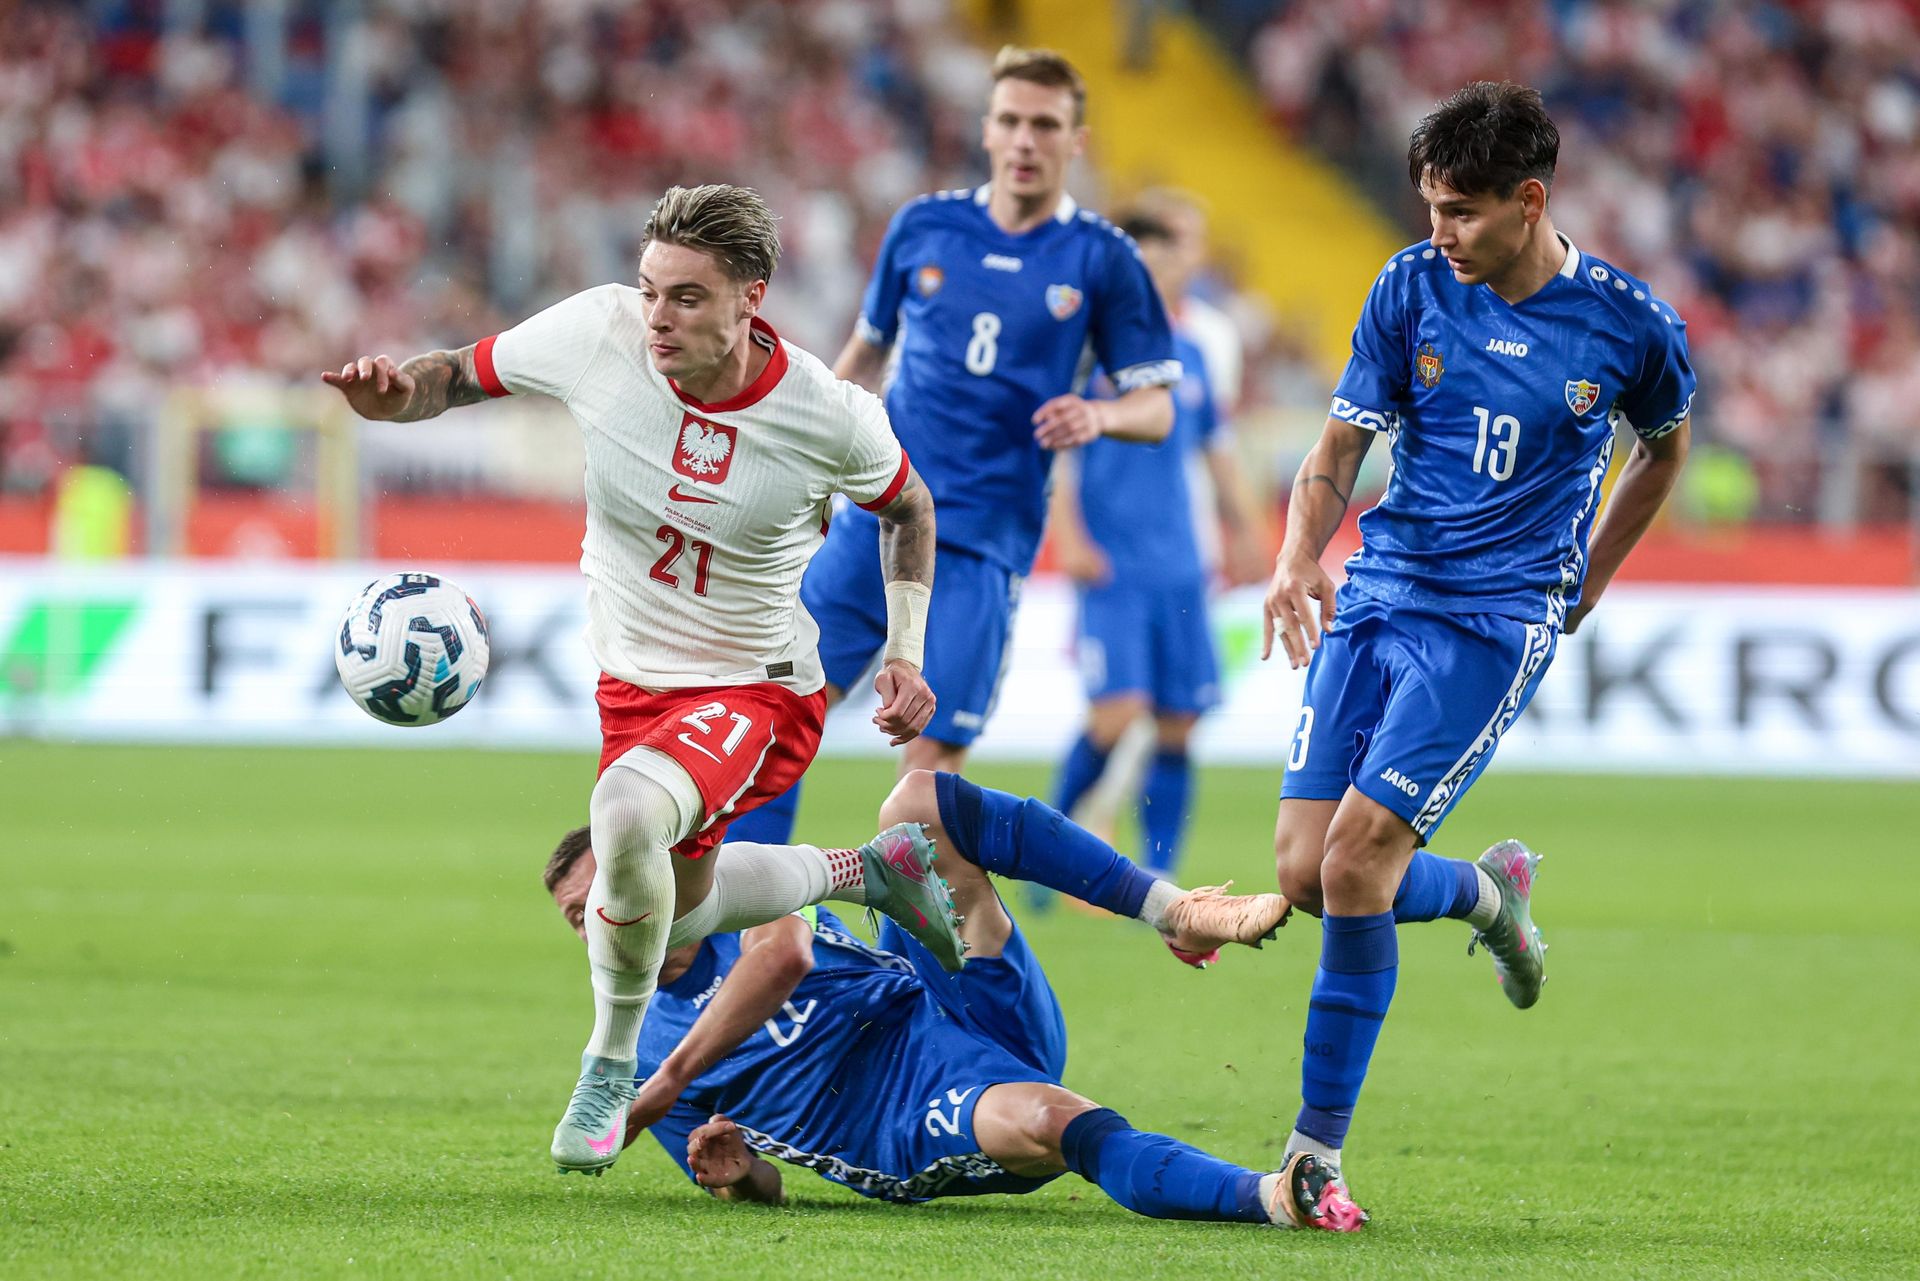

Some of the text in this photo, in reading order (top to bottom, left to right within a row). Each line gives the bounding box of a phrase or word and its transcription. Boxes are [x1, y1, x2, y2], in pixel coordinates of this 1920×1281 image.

[965, 311, 1001, 376] 8
[1485, 338, 1528, 358] JAKO
[1472, 406, 1521, 482] 13
[650, 524, 714, 597] 21
[680, 701, 752, 757] 21
[1380, 767, 1420, 798] JAKO
